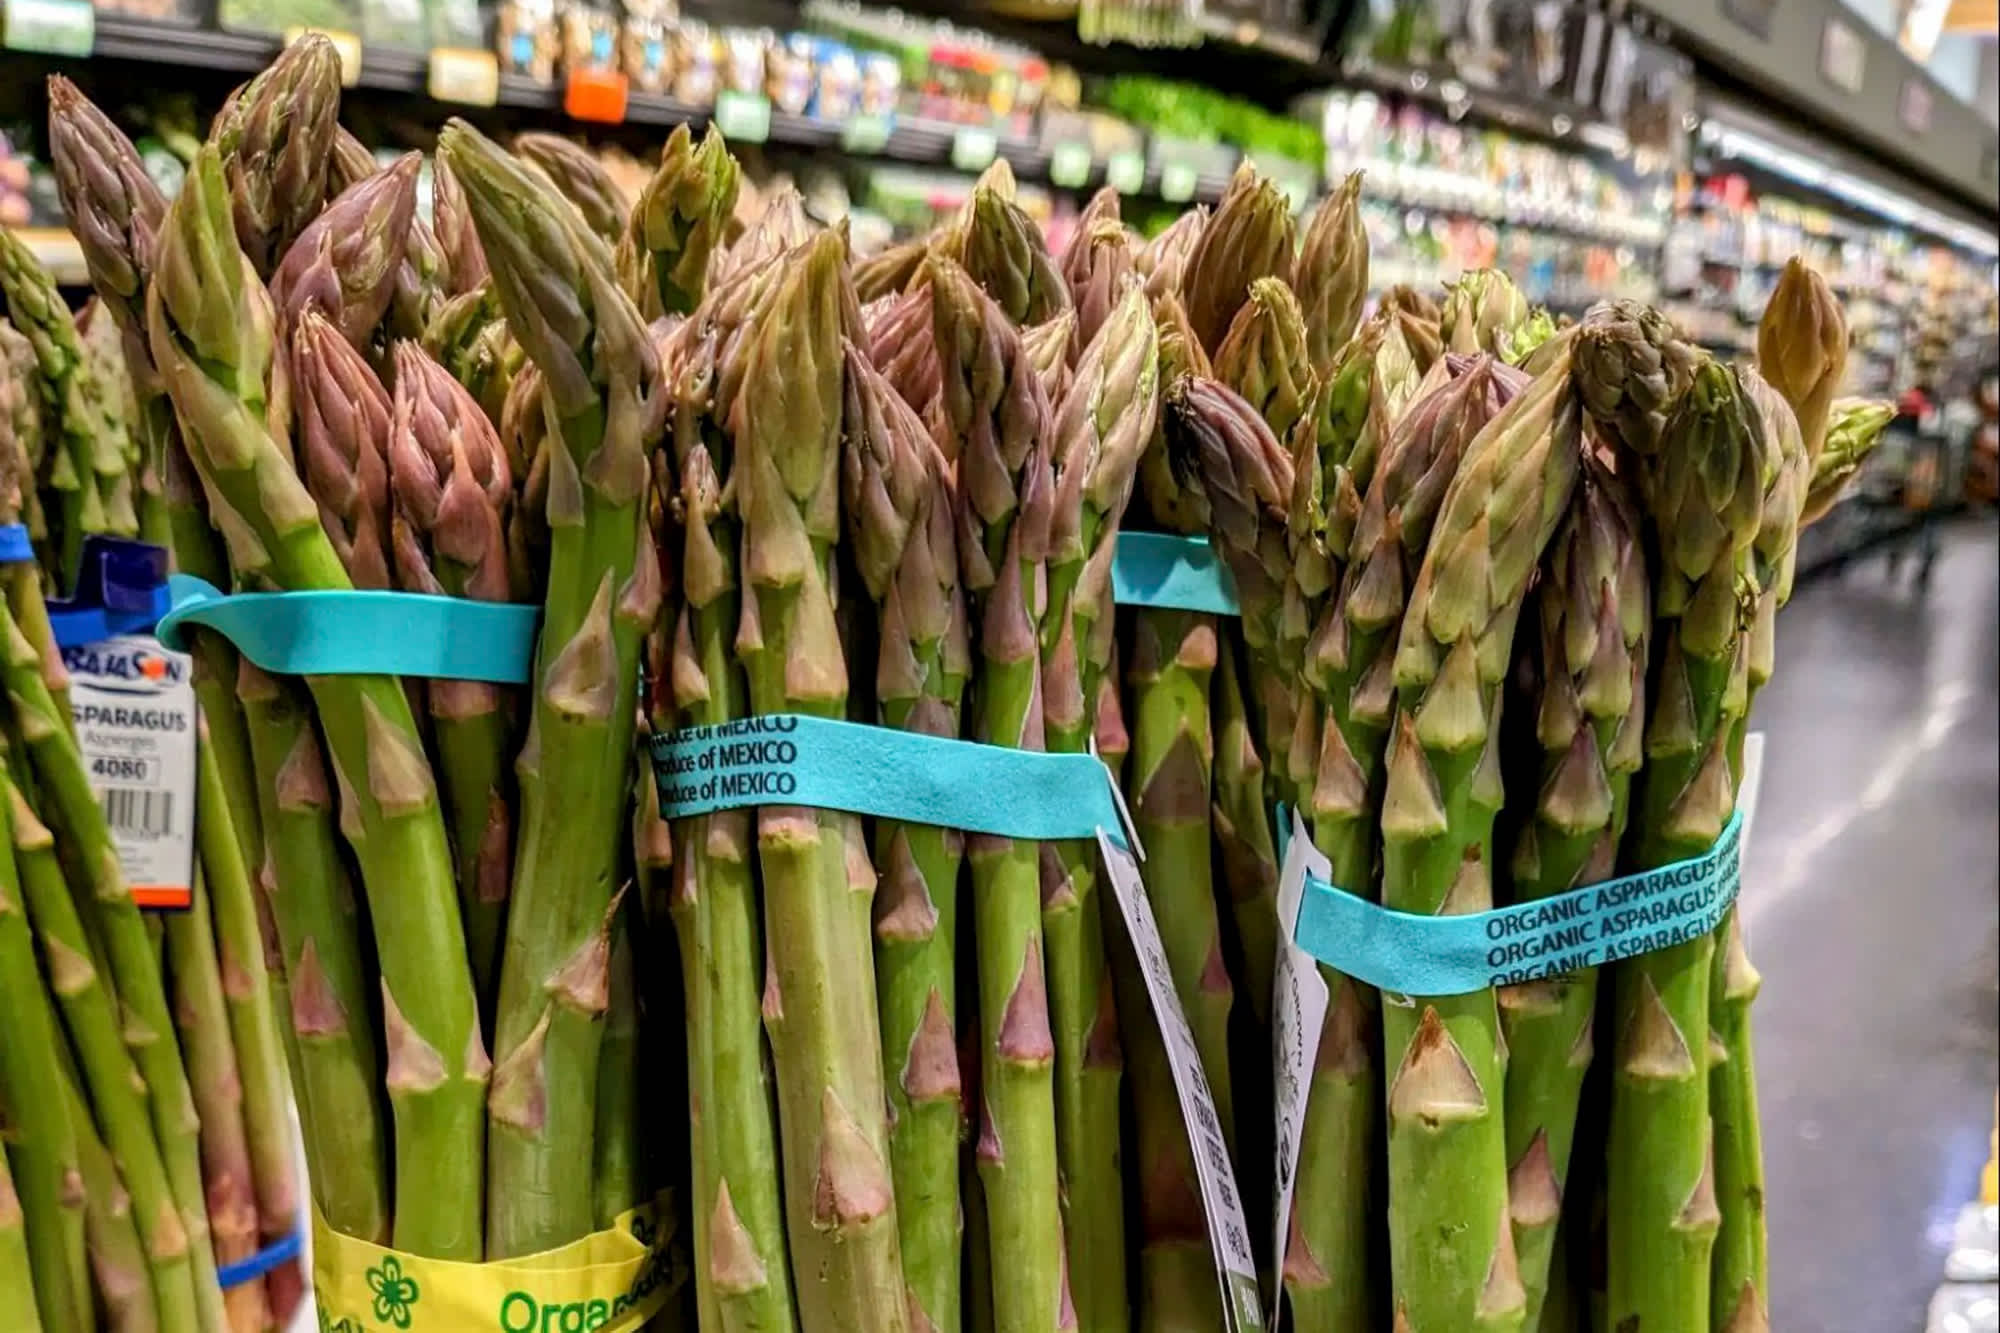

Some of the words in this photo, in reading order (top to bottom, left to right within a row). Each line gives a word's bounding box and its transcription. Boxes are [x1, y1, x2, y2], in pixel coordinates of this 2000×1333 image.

[72, 704, 188, 732] SPARAGUS
[91, 757, 148, 780] 4080
[698, 745, 717, 771] of
[719, 740, 798, 767] MEXICO
[700, 775, 719, 800] of
[721, 771, 797, 797] MEXICO
[1486, 894, 1592, 940] ORGANIC
[1595, 855, 1716, 911] ASPARAGUS
[1487, 922, 1596, 968] ORGANIC
[1601, 882, 1717, 937] ASPARAGUS
[1605, 906, 1718, 961] ASPARAGUS
